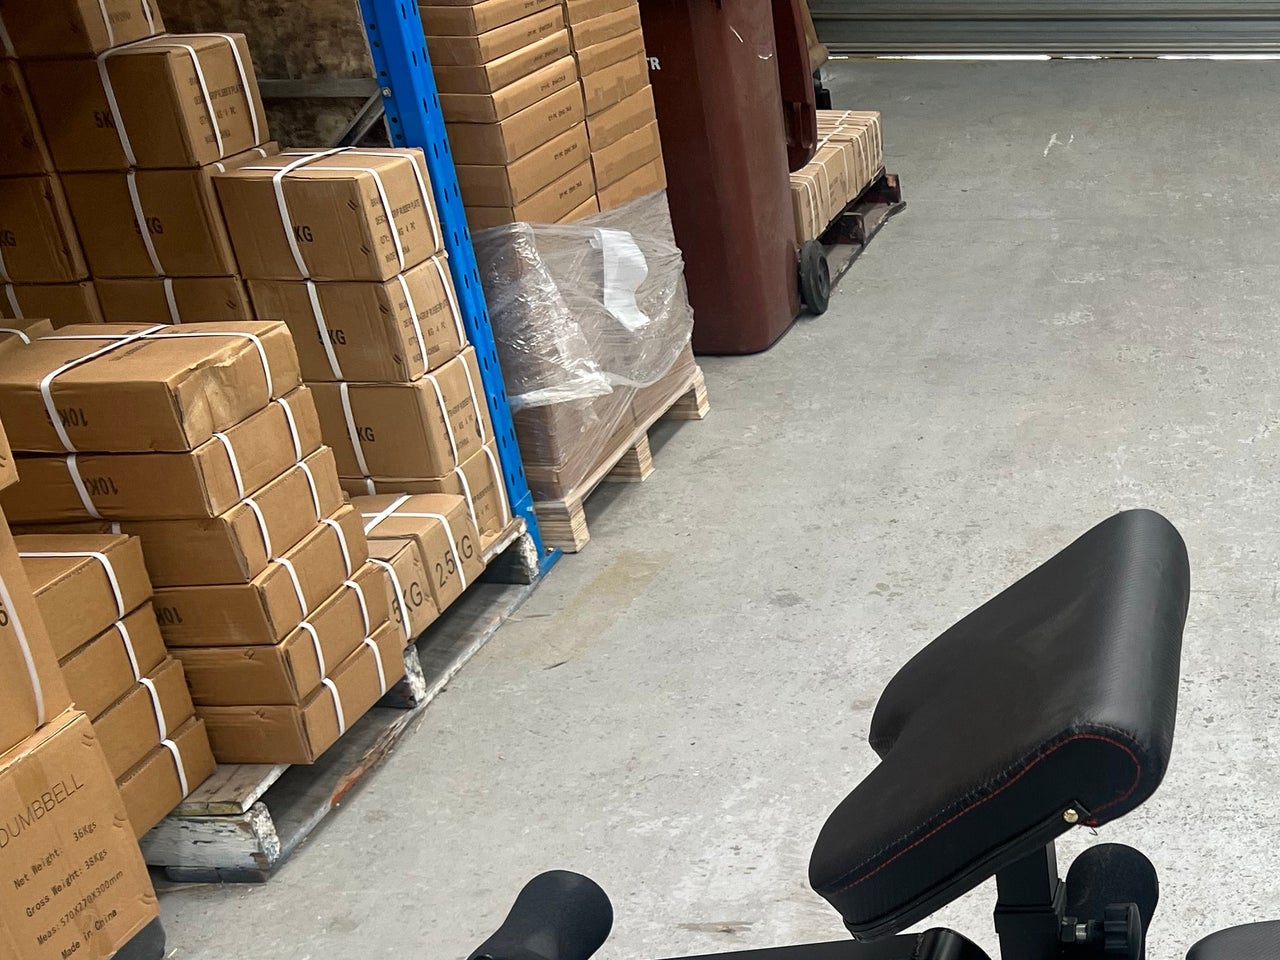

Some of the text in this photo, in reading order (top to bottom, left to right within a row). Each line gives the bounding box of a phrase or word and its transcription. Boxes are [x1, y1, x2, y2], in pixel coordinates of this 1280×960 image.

[93, 111, 114, 128] 5K
[294, 225, 313, 242] KG
[45, 408, 88, 427] 10K
[347, 427, 375, 442] KG
[82, 477, 118, 495] 10K
[157, 607, 183, 624] 10K
[0, 773, 84, 849] DUMBBELL
[13, 821, 97, 890] Net Weight: 36Kgs
[25, 895, 50, 918] Gross
[51, 867, 83, 897] Weight:
[61, 940, 81, 960] Made
[94, 908, 118, 931] China
